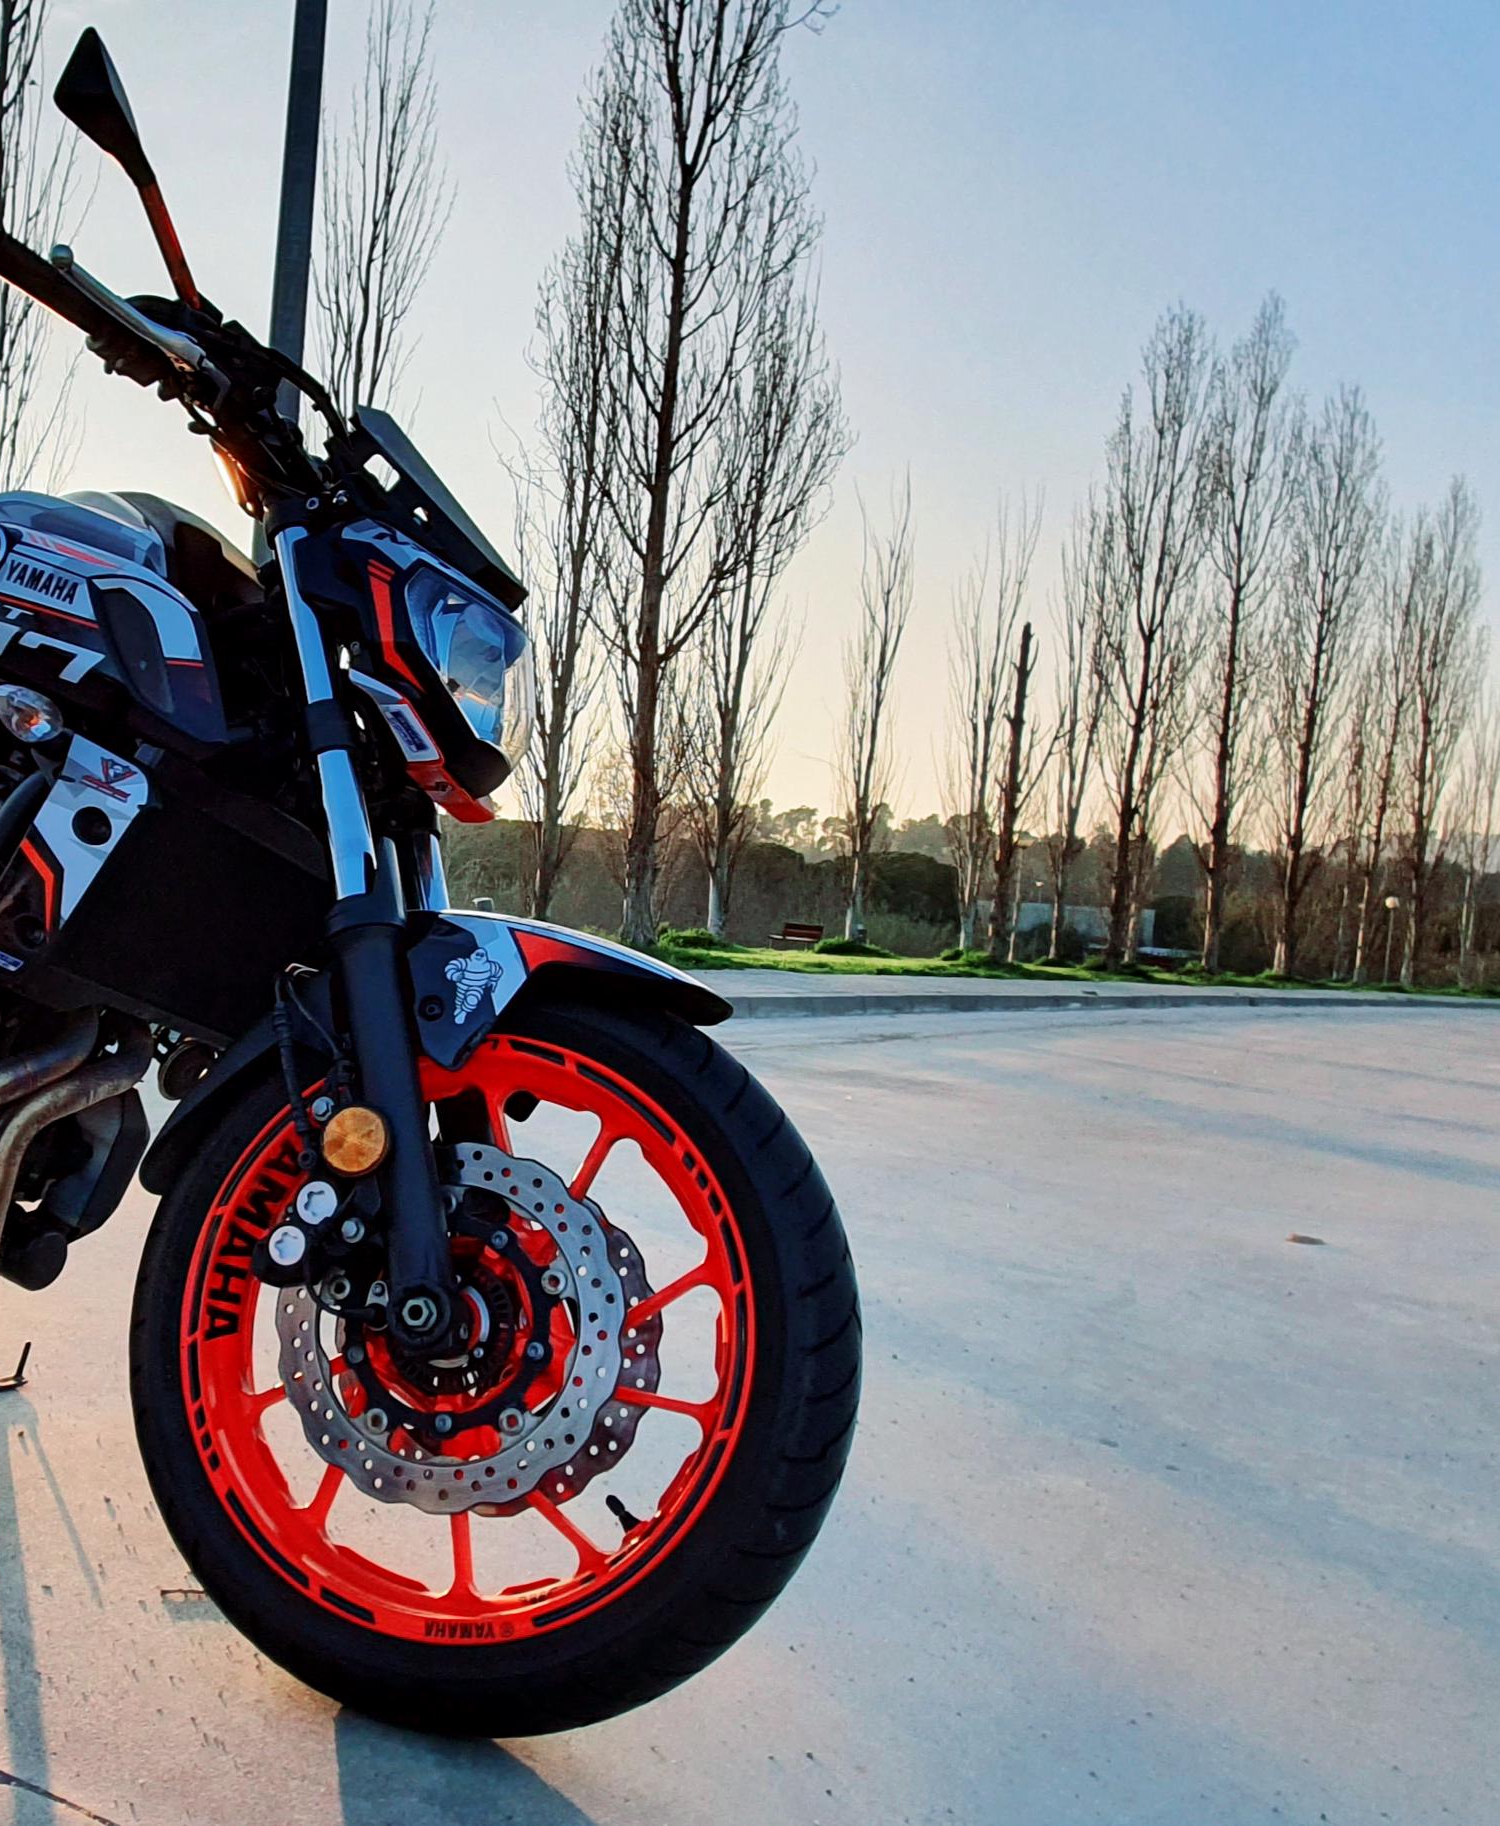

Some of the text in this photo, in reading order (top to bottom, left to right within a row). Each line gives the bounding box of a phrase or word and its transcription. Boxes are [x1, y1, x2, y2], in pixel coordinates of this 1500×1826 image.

[5, 559, 79, 606] YAMAHA
[204, 1139, 301, 1342] AMAHA
[423, 1620, 496, 1640] YAMAHA
